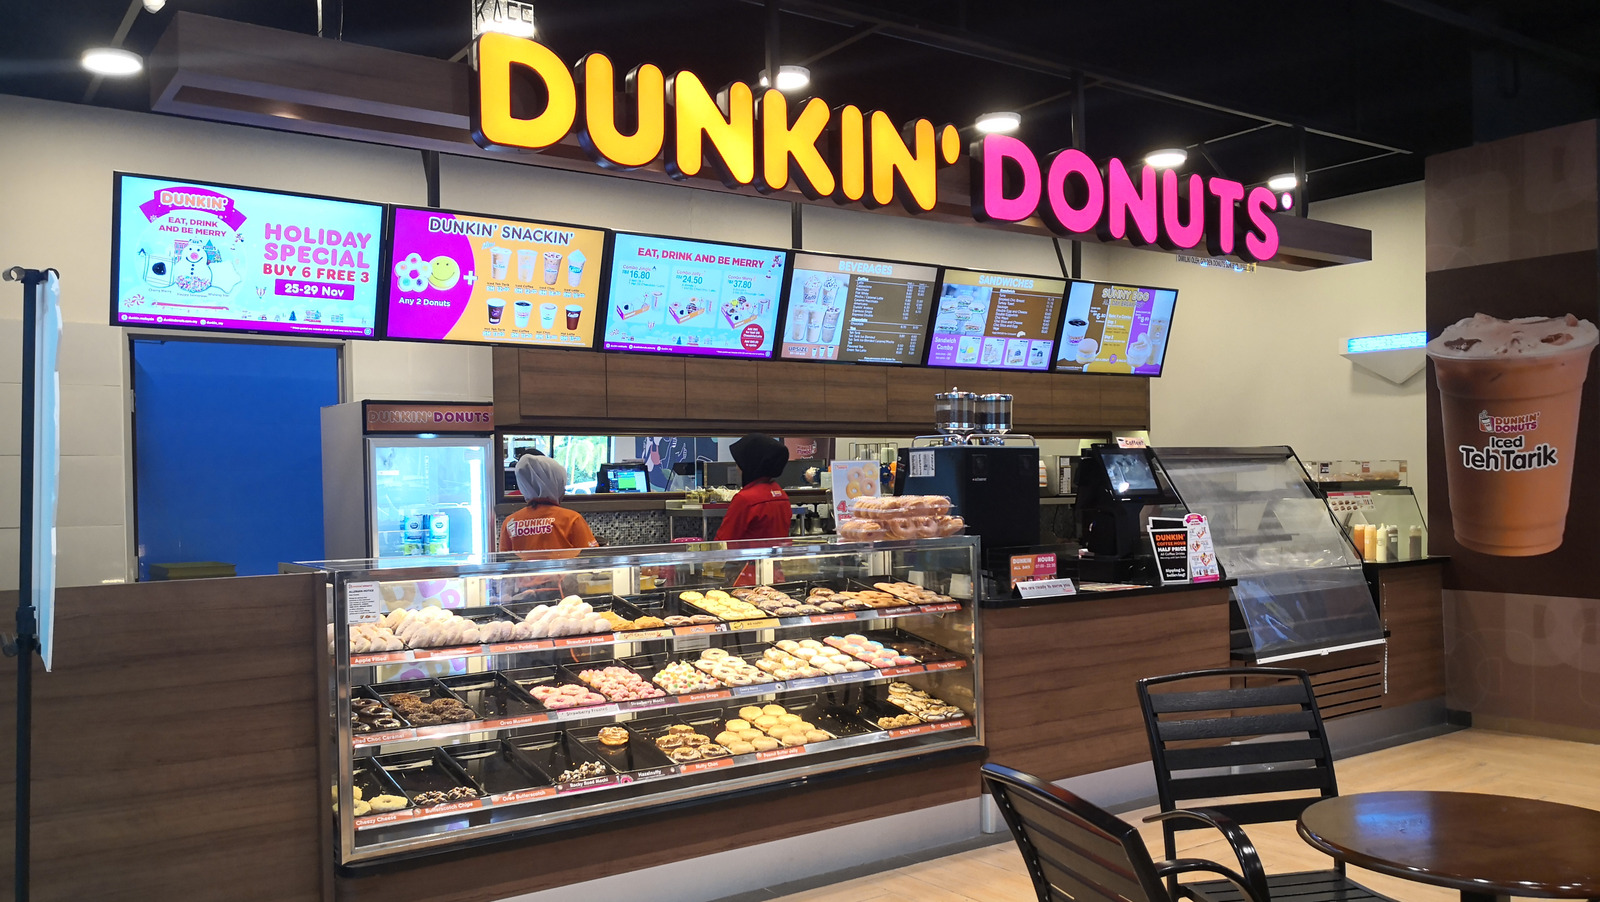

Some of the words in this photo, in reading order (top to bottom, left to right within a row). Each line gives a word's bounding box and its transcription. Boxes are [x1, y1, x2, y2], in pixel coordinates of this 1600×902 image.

[473, 30, 961, 211] DUNKIN'
[980, 133, 1279, 261] DONUTS
[161, 191, 228, 211] DUNKIN'
[168, 216, 189, 227] EAT,
[190, 218, 218, 228] DRINK
[158, 225, 179, 234] AND
[180, 226, 194, 235] BE
[195, 228, 227, 238] MERRY
[264, 222, 372, 249] HOLIDAY
[429, 216, 498, 238] DUNKIN'
[502, 226, 574, 245] SNACKIN'
[264, 244, 371, 269] SPECIAL
[638, 247, 660, 260] EAT,
[662, 250, 693, 262] DRINK
[694, 254, 716, 263] AND
[718, 256, 731, 265] BE
[732, 258, 765, 269] MERRY
[263, 263, 297, 277] BUY
[302, 266, 311, 278] 6
[316, 269, 356, 282] FREE
[360, 271, 370, 283] 3
[838, 260, 893, 275] BEVERAGES
[630, 270, 651, 280] 16.80
[682, 275, 703, 285] 24.50
[733, 280, 752, 289] 37.80
[979, 275, 1034, 289] SANDWICHES
[284, 282, 320, 296] 25-29
[322, 284, 345, 297] Nov
[1102, 288, 1133, 301] SUNNY
[398, 297, 415, 306] Any
[423, 299, 451, 307] Donuts
[368, 410, 433, 424] DUNKIN'
[433, 412, 490, 424] DONUTS
[1495, 412, 1540, 425] DUNKIN'
[1495, 422, 1538, 433] DONUTS
[1491, 436, 1523, 449] Iced
[1460, 447, 1500, 470] Teh
[1502, 445, 1557, 470] Tarik
[518, 518, 555, 528] DUNKIN'
[517, 525, 553, 536] DONUTS
[513, 717, 533, 725] Moment
[367, 735, 382, 743] Choc
[382, 733, 405, 741] Caramel
[502, 794, 515, 802] Oreo
[515, 790, 546, 800] Butterscotch
[425, 804, 458, 814] Butterscotch
[458, 802, 474, 810] Chips
[377, 815, 397, 823] Cheese
